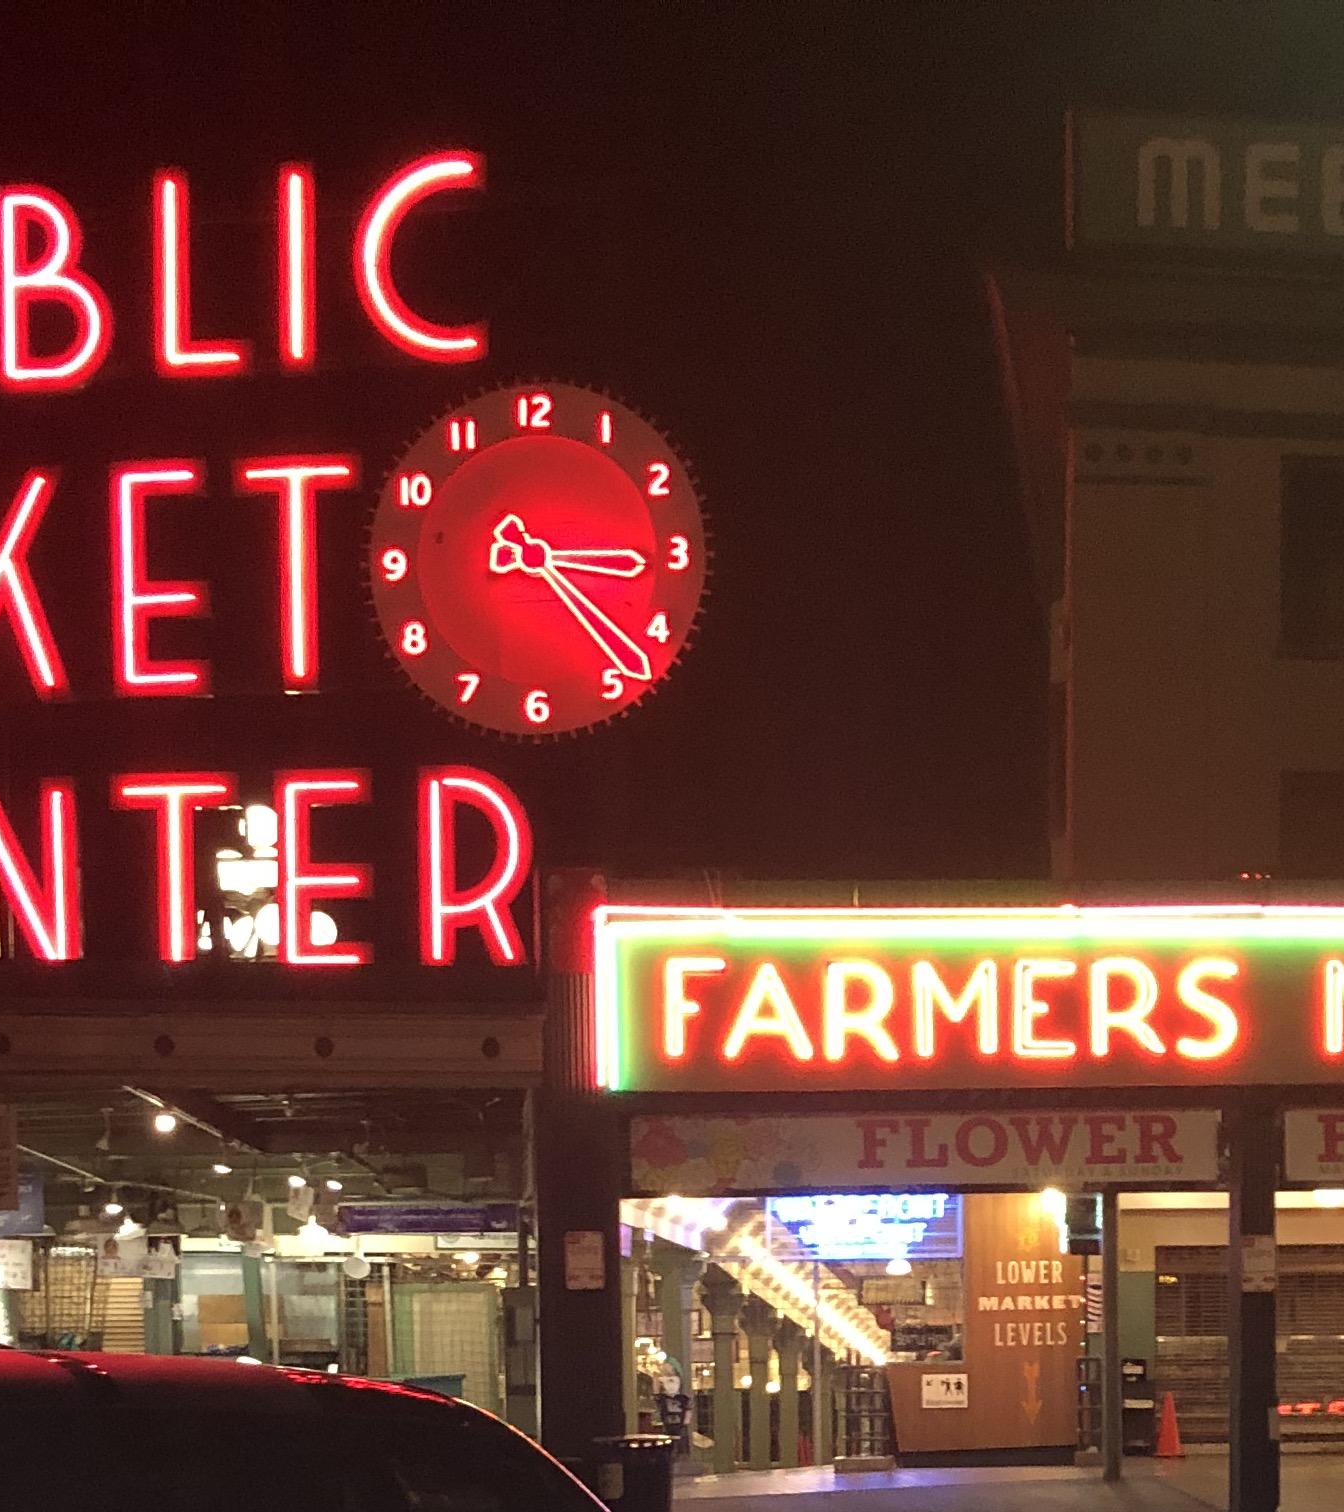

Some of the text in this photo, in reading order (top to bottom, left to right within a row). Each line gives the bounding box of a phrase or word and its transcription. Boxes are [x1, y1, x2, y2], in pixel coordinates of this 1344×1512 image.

[518, 394, 552, 428] 12
[451, 421, 476, 451] 11
[601, 414, 612, 443] 1
[400, 473, 432, 506] 10
[648, 463, 670, 496] 2
[382, 549, 407, 580] 9
[667, 536, 689, 570] 3
[403, 621, 427, 655] 8
[647, 612, 670, 644] 4
[457, 674, 480, 702] 7
[601, 668, 624, 699] 5
[525, 690, 550, 722] 6
[660, 954, 1246, 1064] FARMERS
[857, 1114, 1185, 1169] FLOWER
[996, 1260, 1063, 1284] LOWER
[978, 1294, 1083, 1311] MARKET
[994, 1322, 1067, 1346] LEVELS
